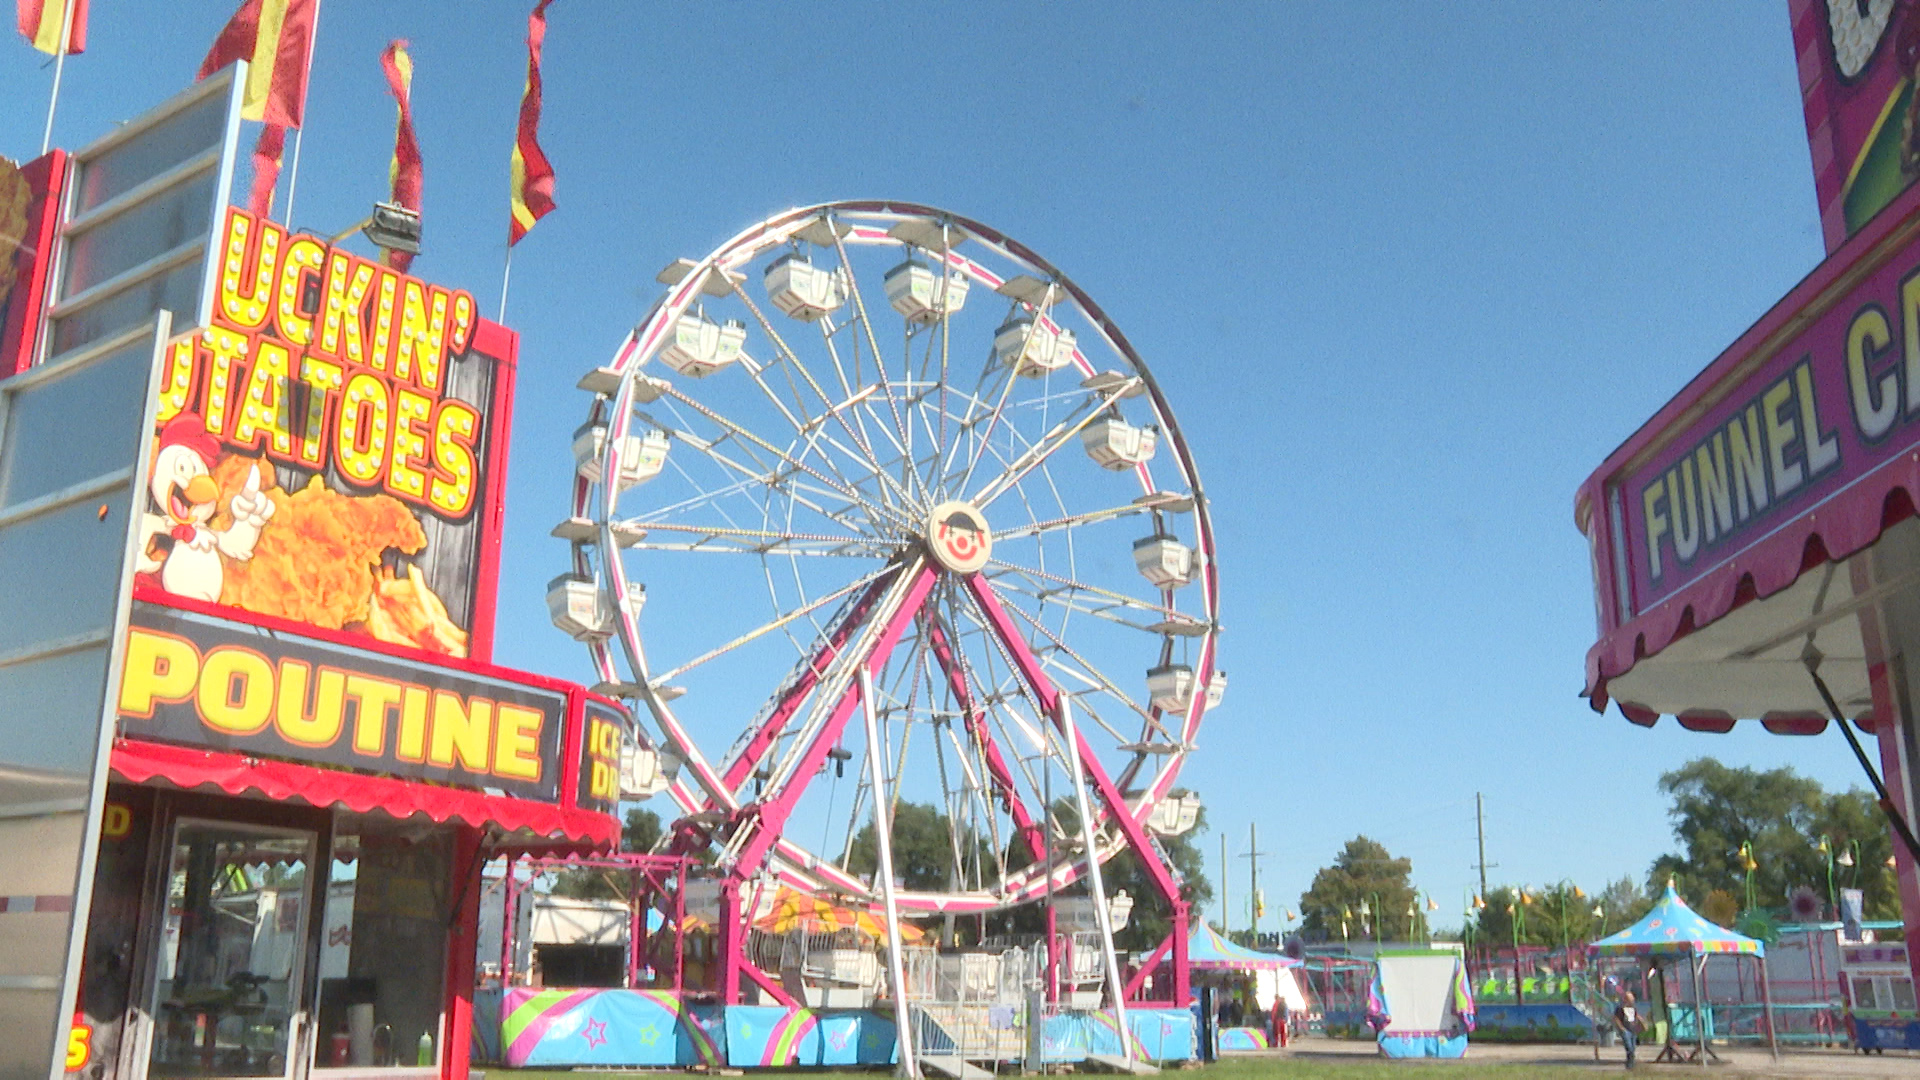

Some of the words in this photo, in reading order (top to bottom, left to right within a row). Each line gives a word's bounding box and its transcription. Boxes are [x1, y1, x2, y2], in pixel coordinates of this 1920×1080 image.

[1642, 361, 1840, 581] FUNNEL
[118, 629, 543, 780] POUTINE
[590, 717, 620, 759] ICE
